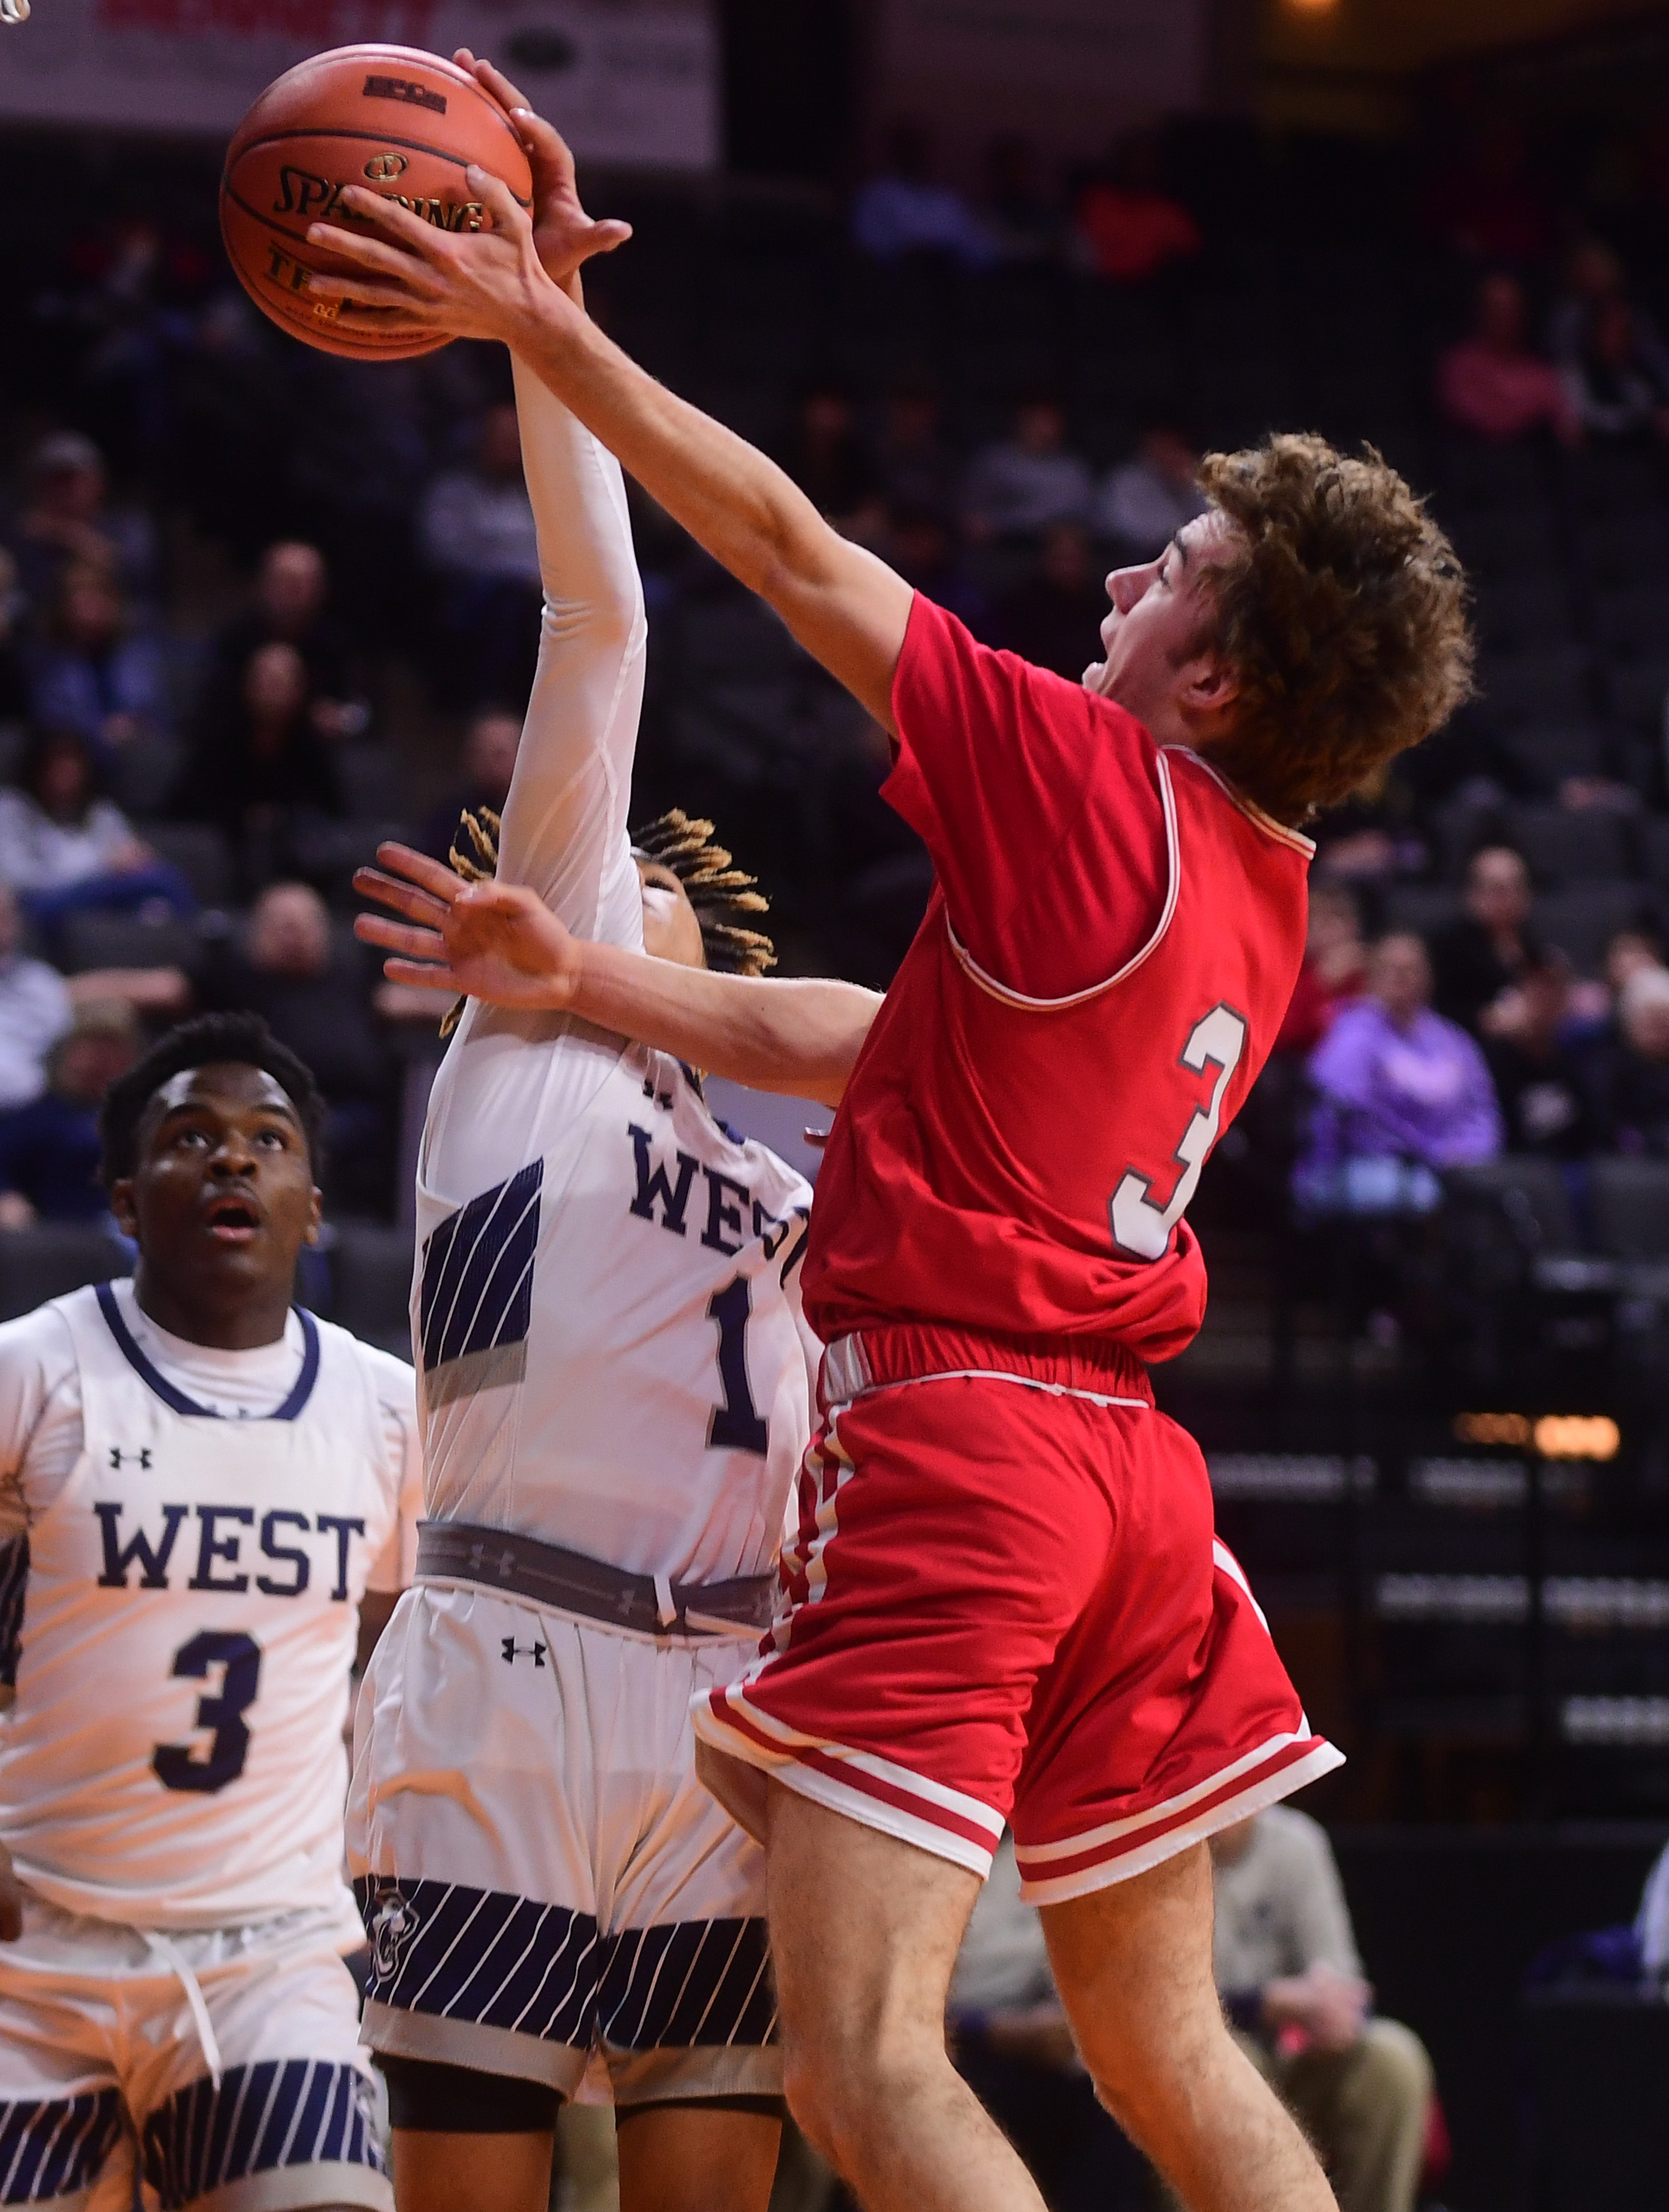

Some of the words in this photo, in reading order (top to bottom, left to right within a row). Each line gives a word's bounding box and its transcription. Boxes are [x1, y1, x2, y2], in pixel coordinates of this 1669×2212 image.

[273, 165, 484, 233] SPAING
[1107, 999, 1249, 1261] 3
[705, 1274, 768, 1461] 1
[94, 1501, 366, 1602] WEST
[151, 1630, 261, 1794] 3
